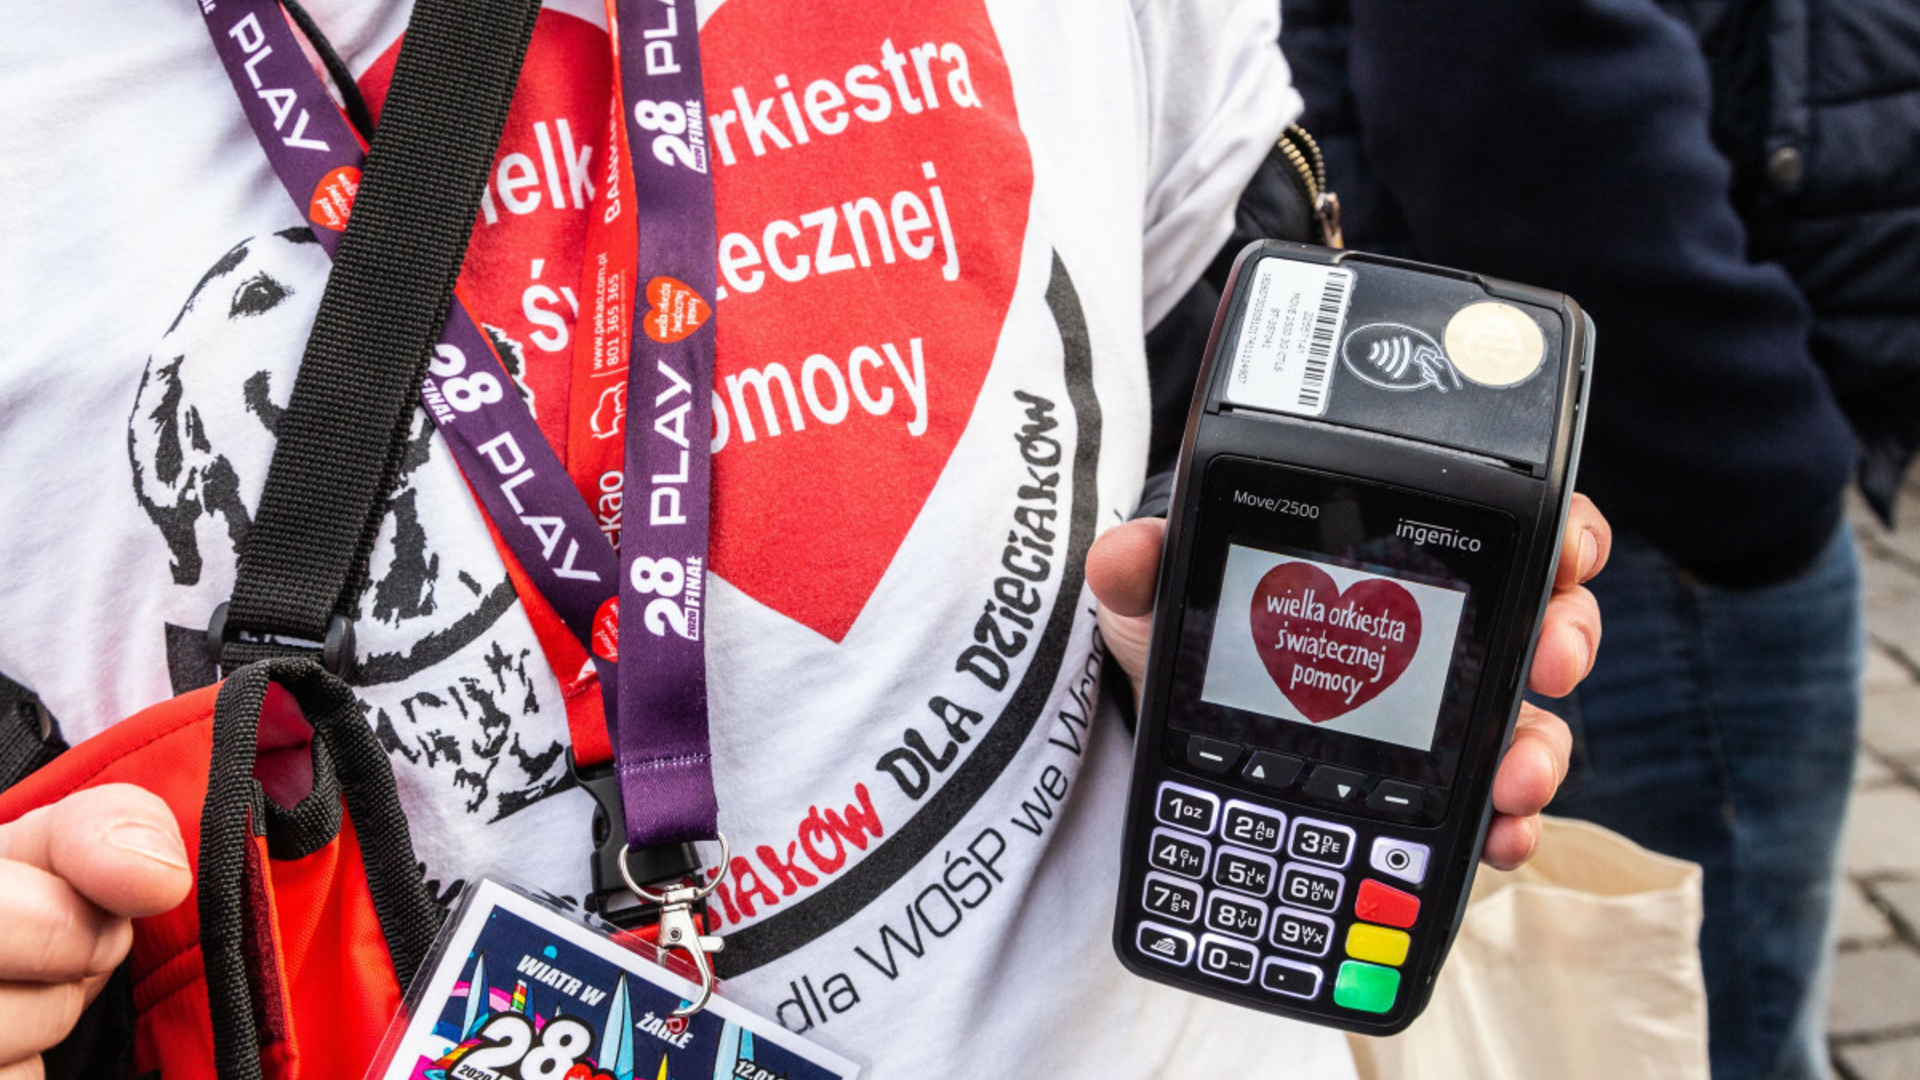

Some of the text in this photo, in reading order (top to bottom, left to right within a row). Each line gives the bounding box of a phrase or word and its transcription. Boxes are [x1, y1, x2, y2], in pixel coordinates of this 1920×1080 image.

[643, 0, 681, 75] PL
[229, 12, 330, 152] PLAY
[634, 99, 707, 174] 28
[715, 161, 961, 302] ecznej
[593, 252, 608, 370] www.pekao.com.pl
[606, 273, 620, 366] 801 365 365
[650, 360, 692, 525] PLAY
[477, 431, 601, 582] PLAY
[1233, 490, 1320, 519] Move/2500
[1396, 519, 1482, 552] ingenico
[630, 556, 700, 641] 28
[684, 556, 702, 637] 2020 FINAŁ
[1266, 589, 1406, 643] wielka orkiestra
[1275, 621, 1387, 683] świątecznej
[1290, 663, 1364, 705] pomocy
[876, 696, 984, 800] DLA
[776, 973, 860, 1035] dla
[854, 827, 1007, 981] WOŚP
[1011, 765, 1069, 837] we
[516, 954, 607, 1007] WIATR W
[1208, 948, 1227, 970] 0
[451, 1016, 591, 1080] 28
